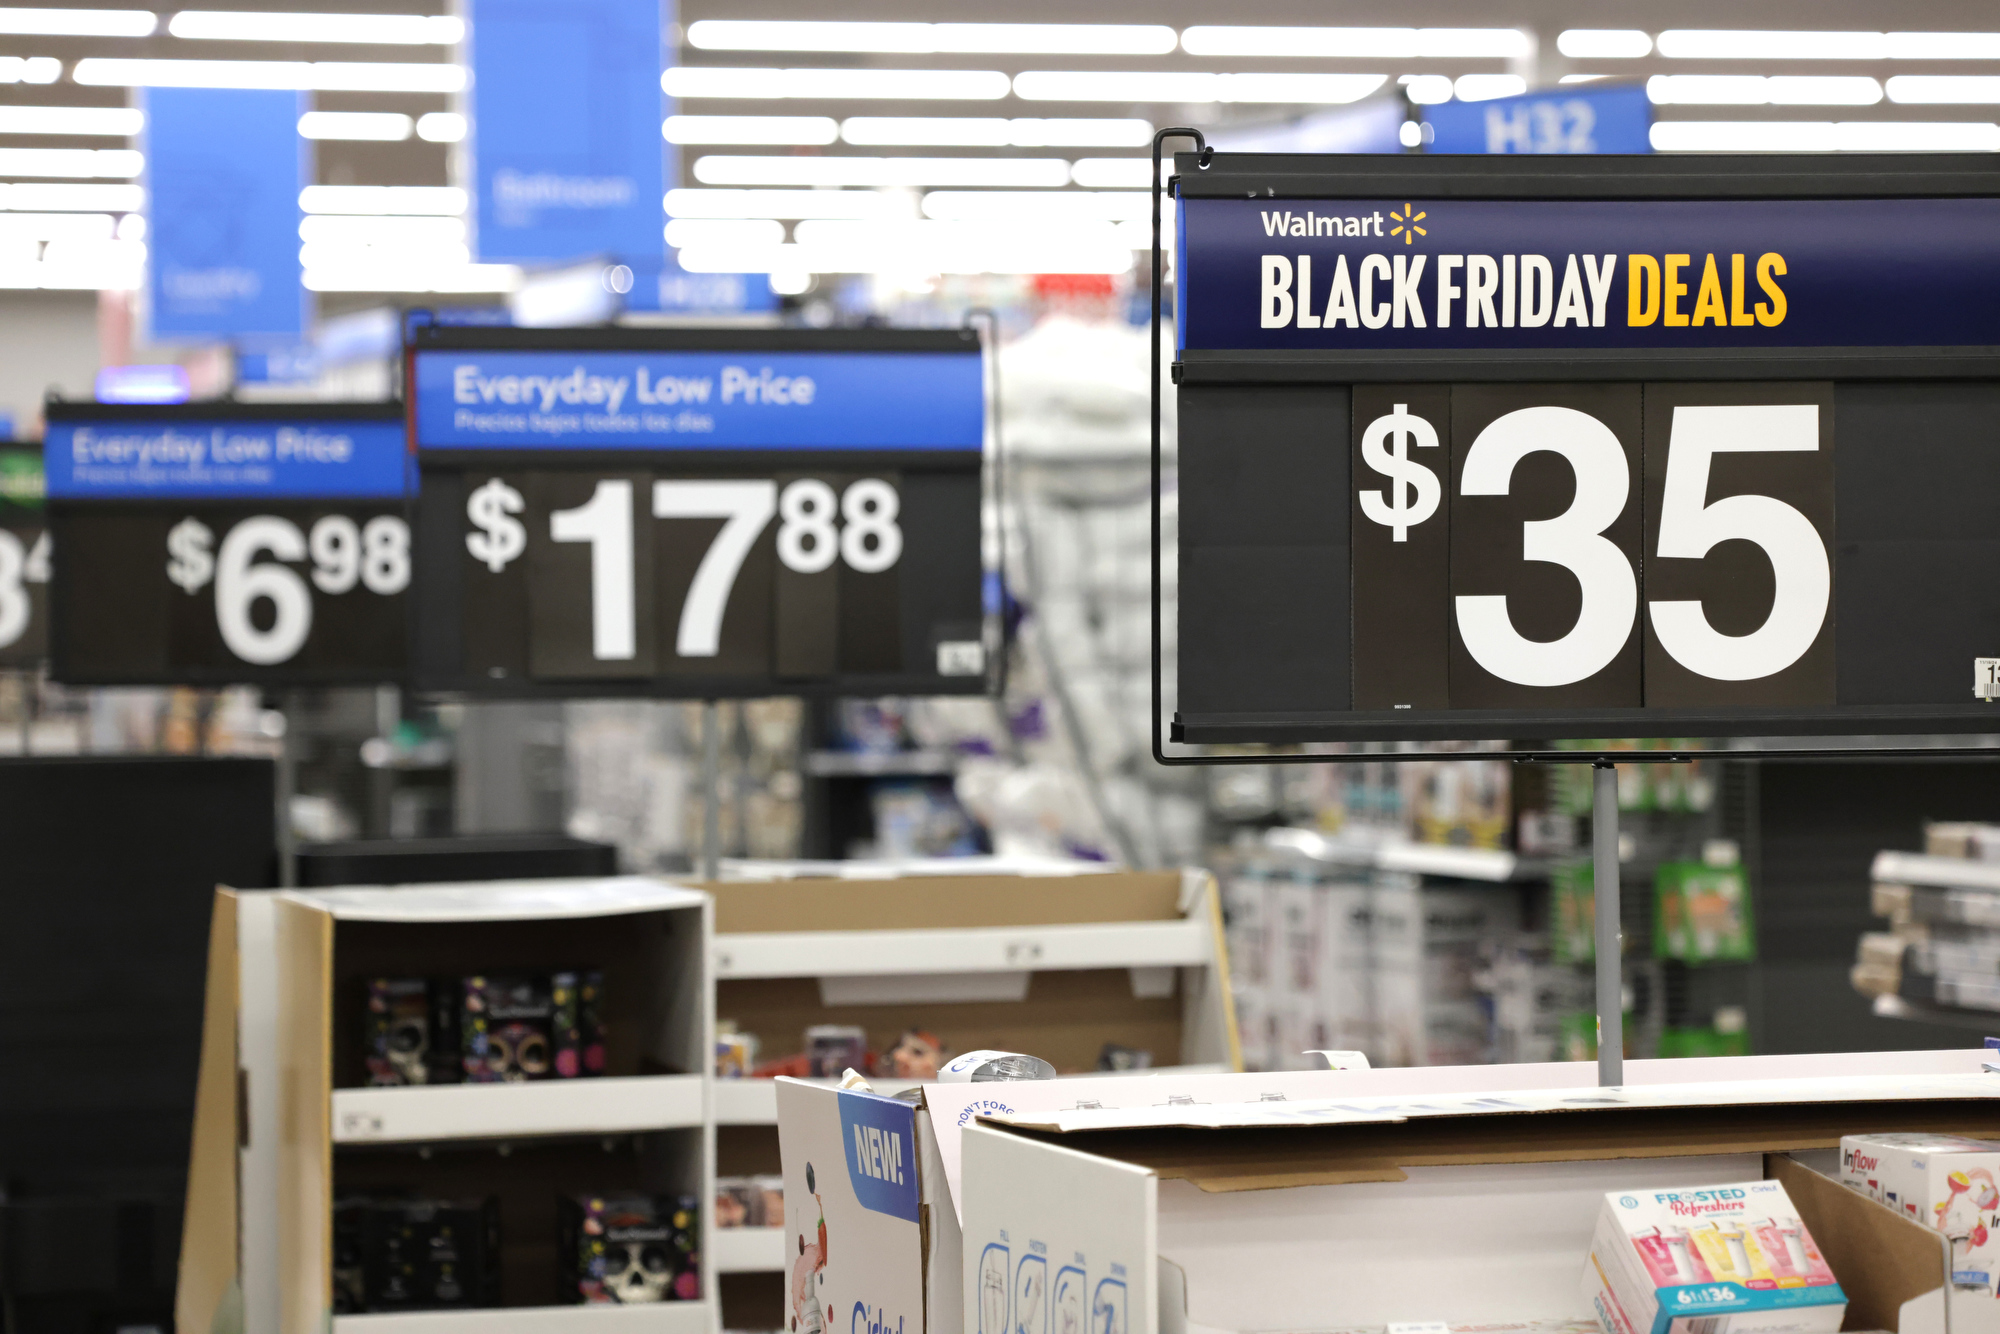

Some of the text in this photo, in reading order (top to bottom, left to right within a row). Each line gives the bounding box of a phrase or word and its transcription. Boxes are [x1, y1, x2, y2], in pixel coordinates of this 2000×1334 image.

[1486, 102, 1597, 154] H32
[1261, 211, 1385, 237] Walmart
[1261, 252, 1788, 329] BLACK FRIDAY DEALS
[454, 365, 816, 415] Everyday Low Price
[73, 427, 353, 470] Everyday Low Price
[1987, 664, 2000, 684] 1
[853, 1123, 904, 1186] NEW!
[1843, 1148, 1878, 1173] Inflow
[1654, 1188, 1746, 1204] FROSTED
[1670, 1199, 1745, 1217] Refreshers
[1677, 1286, 1736, 1304] 6 36
